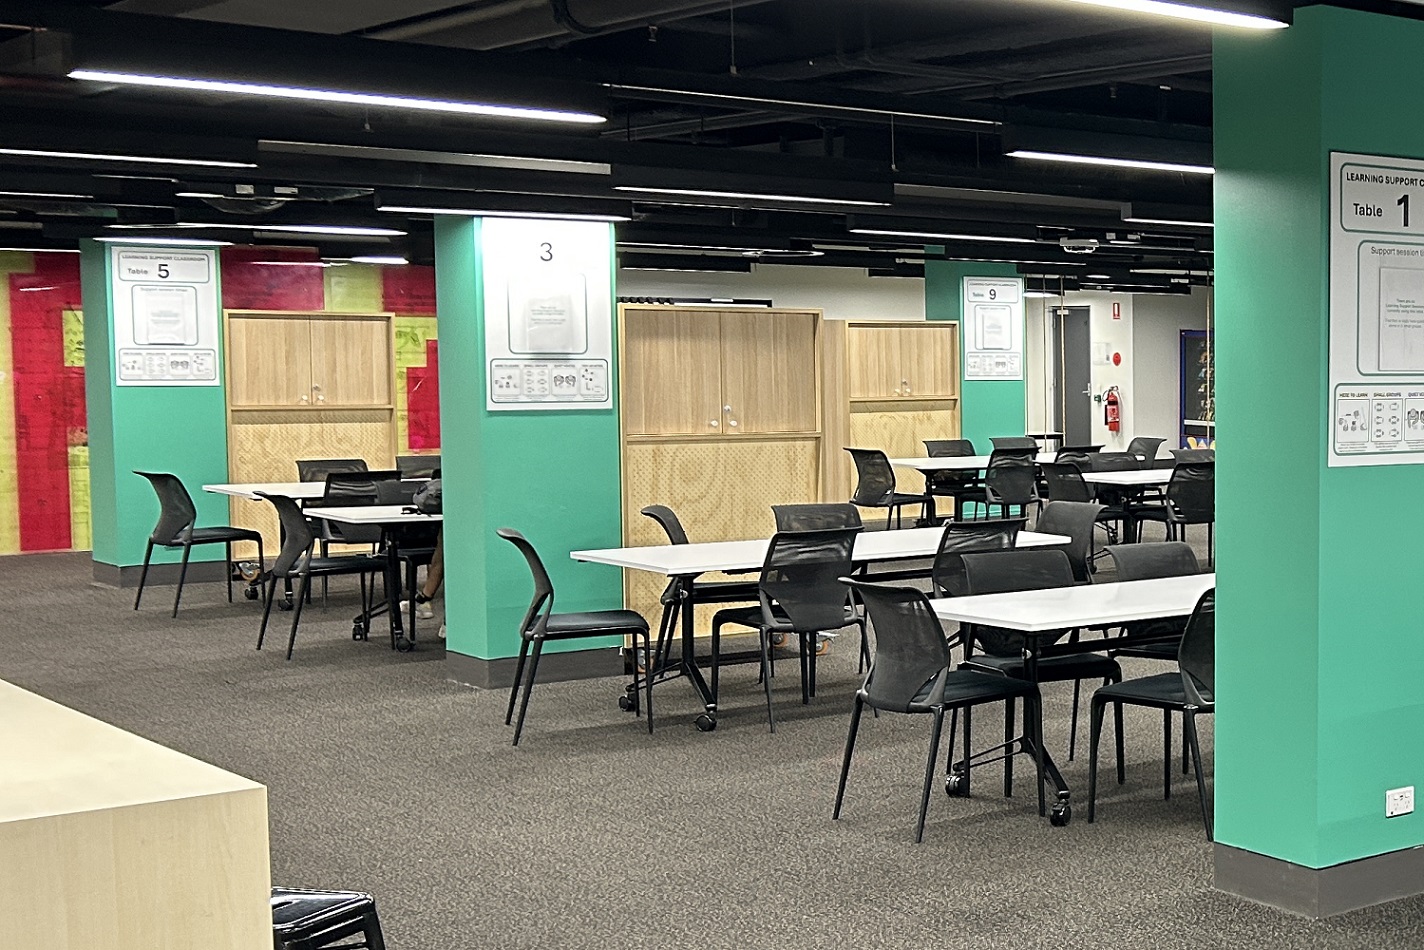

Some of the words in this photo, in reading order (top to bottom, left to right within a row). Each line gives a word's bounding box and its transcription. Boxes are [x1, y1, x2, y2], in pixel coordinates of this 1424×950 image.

[1346, 172, 1384, 184] LEARNING
[1385, 176, 1418, 187] SUPPORT
[1353, 203, 1383, 217] Table
[1397, 194, 1409, 228] 1
[540, 242, 553, 262] 3
[1370, 246, 1395, 256] Support
[1396, 249, 1419, 257] session
[127, 267, 149, 275] Table
[157, 263, 170, 279] 5
[989, 288, 997, 300] 9
